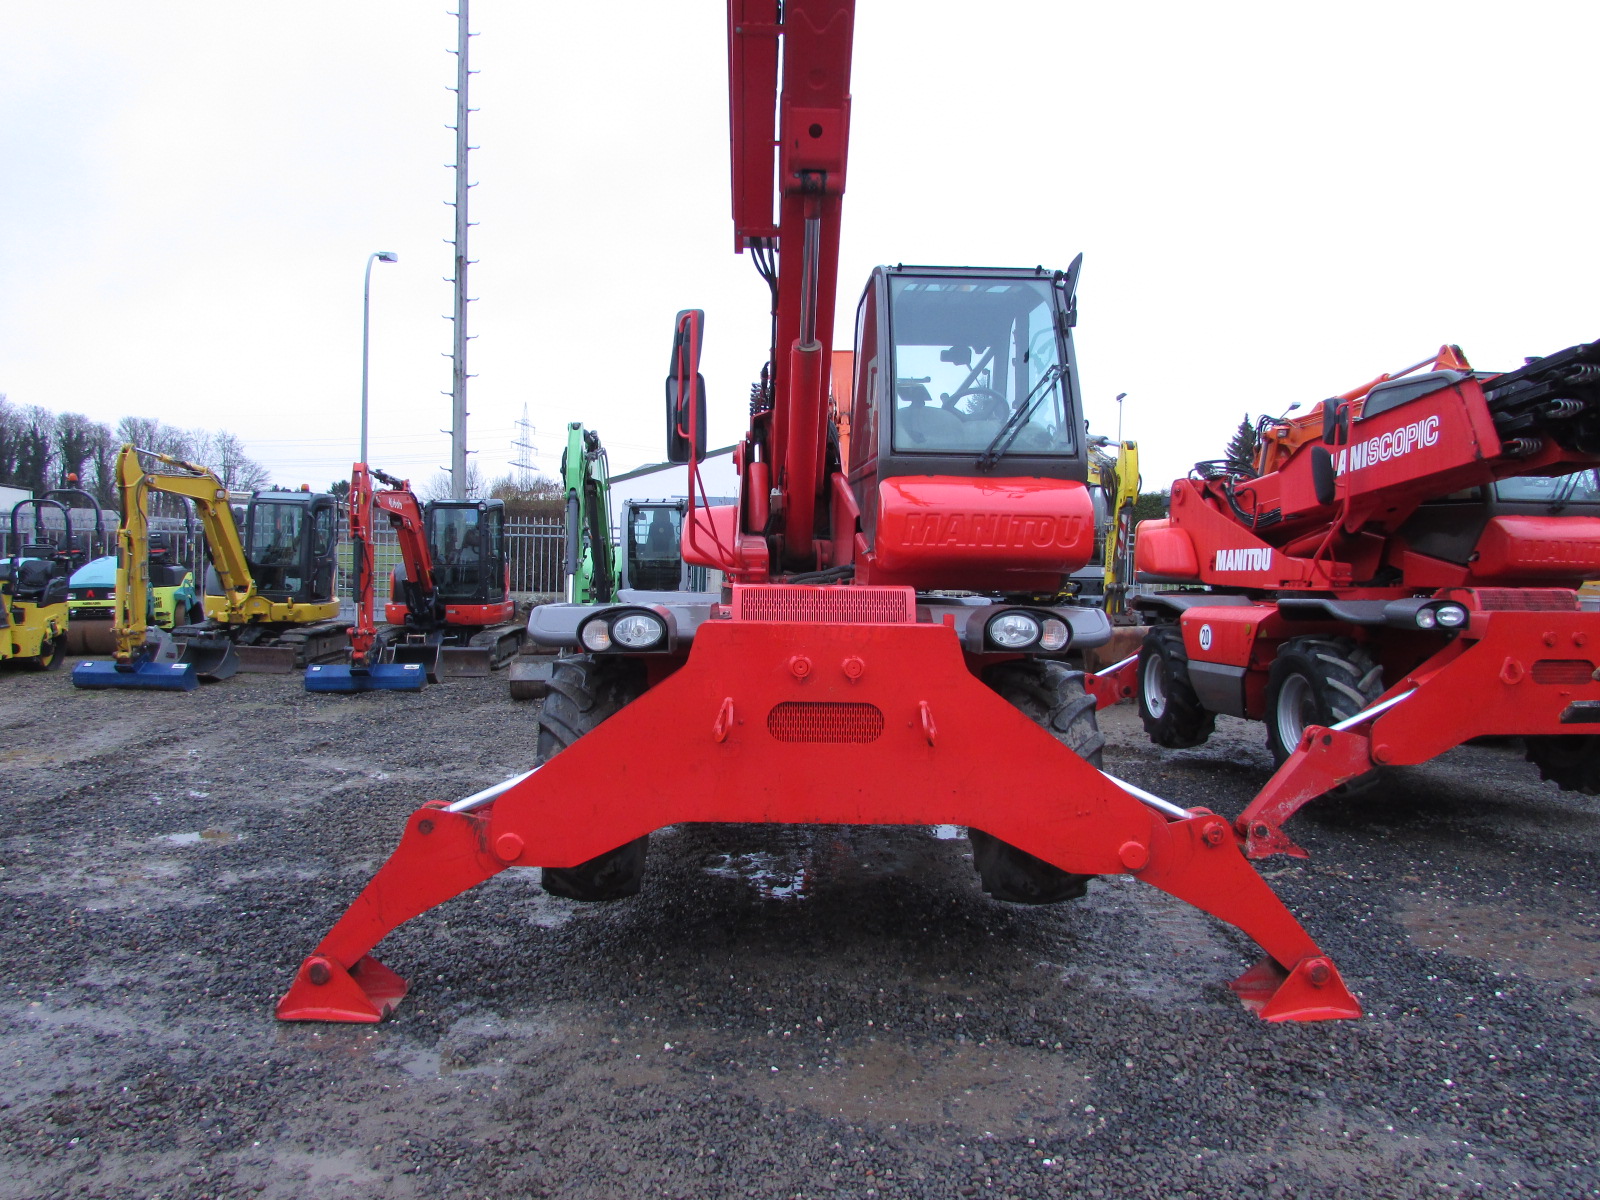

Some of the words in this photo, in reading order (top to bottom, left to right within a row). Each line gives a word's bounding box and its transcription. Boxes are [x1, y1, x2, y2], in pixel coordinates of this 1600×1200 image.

[902, 513, 1082, 548] MANITOU
[1216, 548, 1272, 571] MANITOU
[1201, 629, 1210, 645] 20
